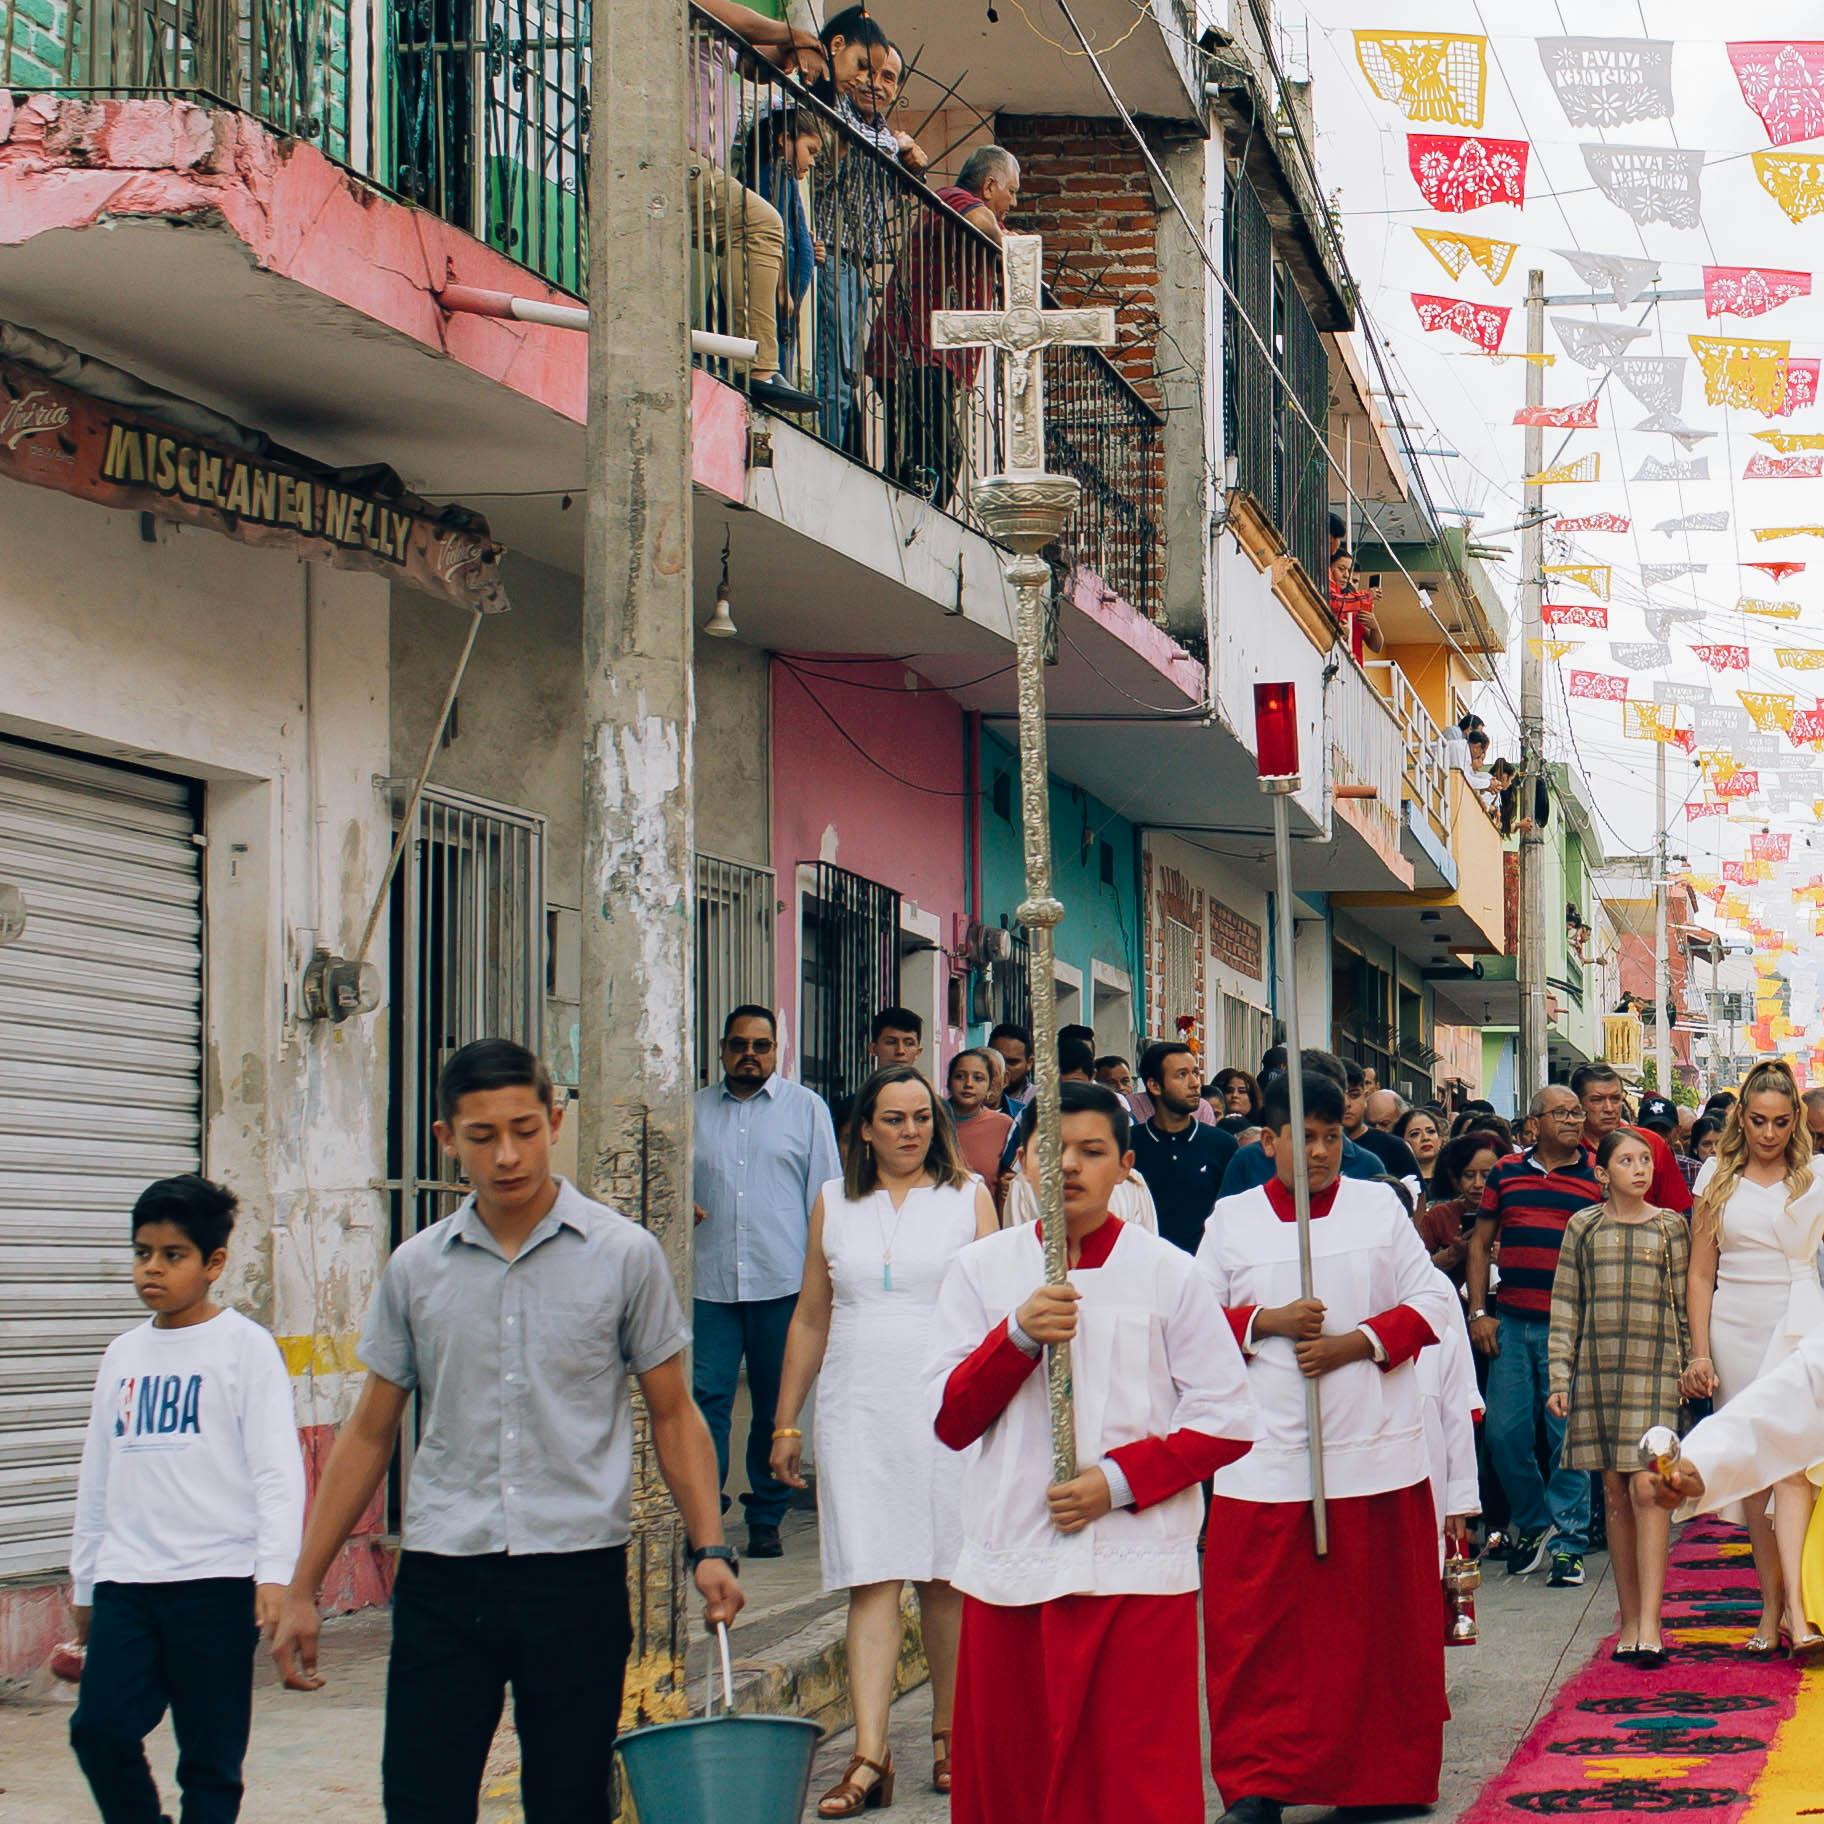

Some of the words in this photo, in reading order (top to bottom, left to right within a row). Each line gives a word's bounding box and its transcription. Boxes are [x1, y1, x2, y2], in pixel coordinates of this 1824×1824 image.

[1611, 154, 1664, 170] VIVA
[326, 488, 411, 561] NELLY
[136, 1374, 202, 1437] NBA
